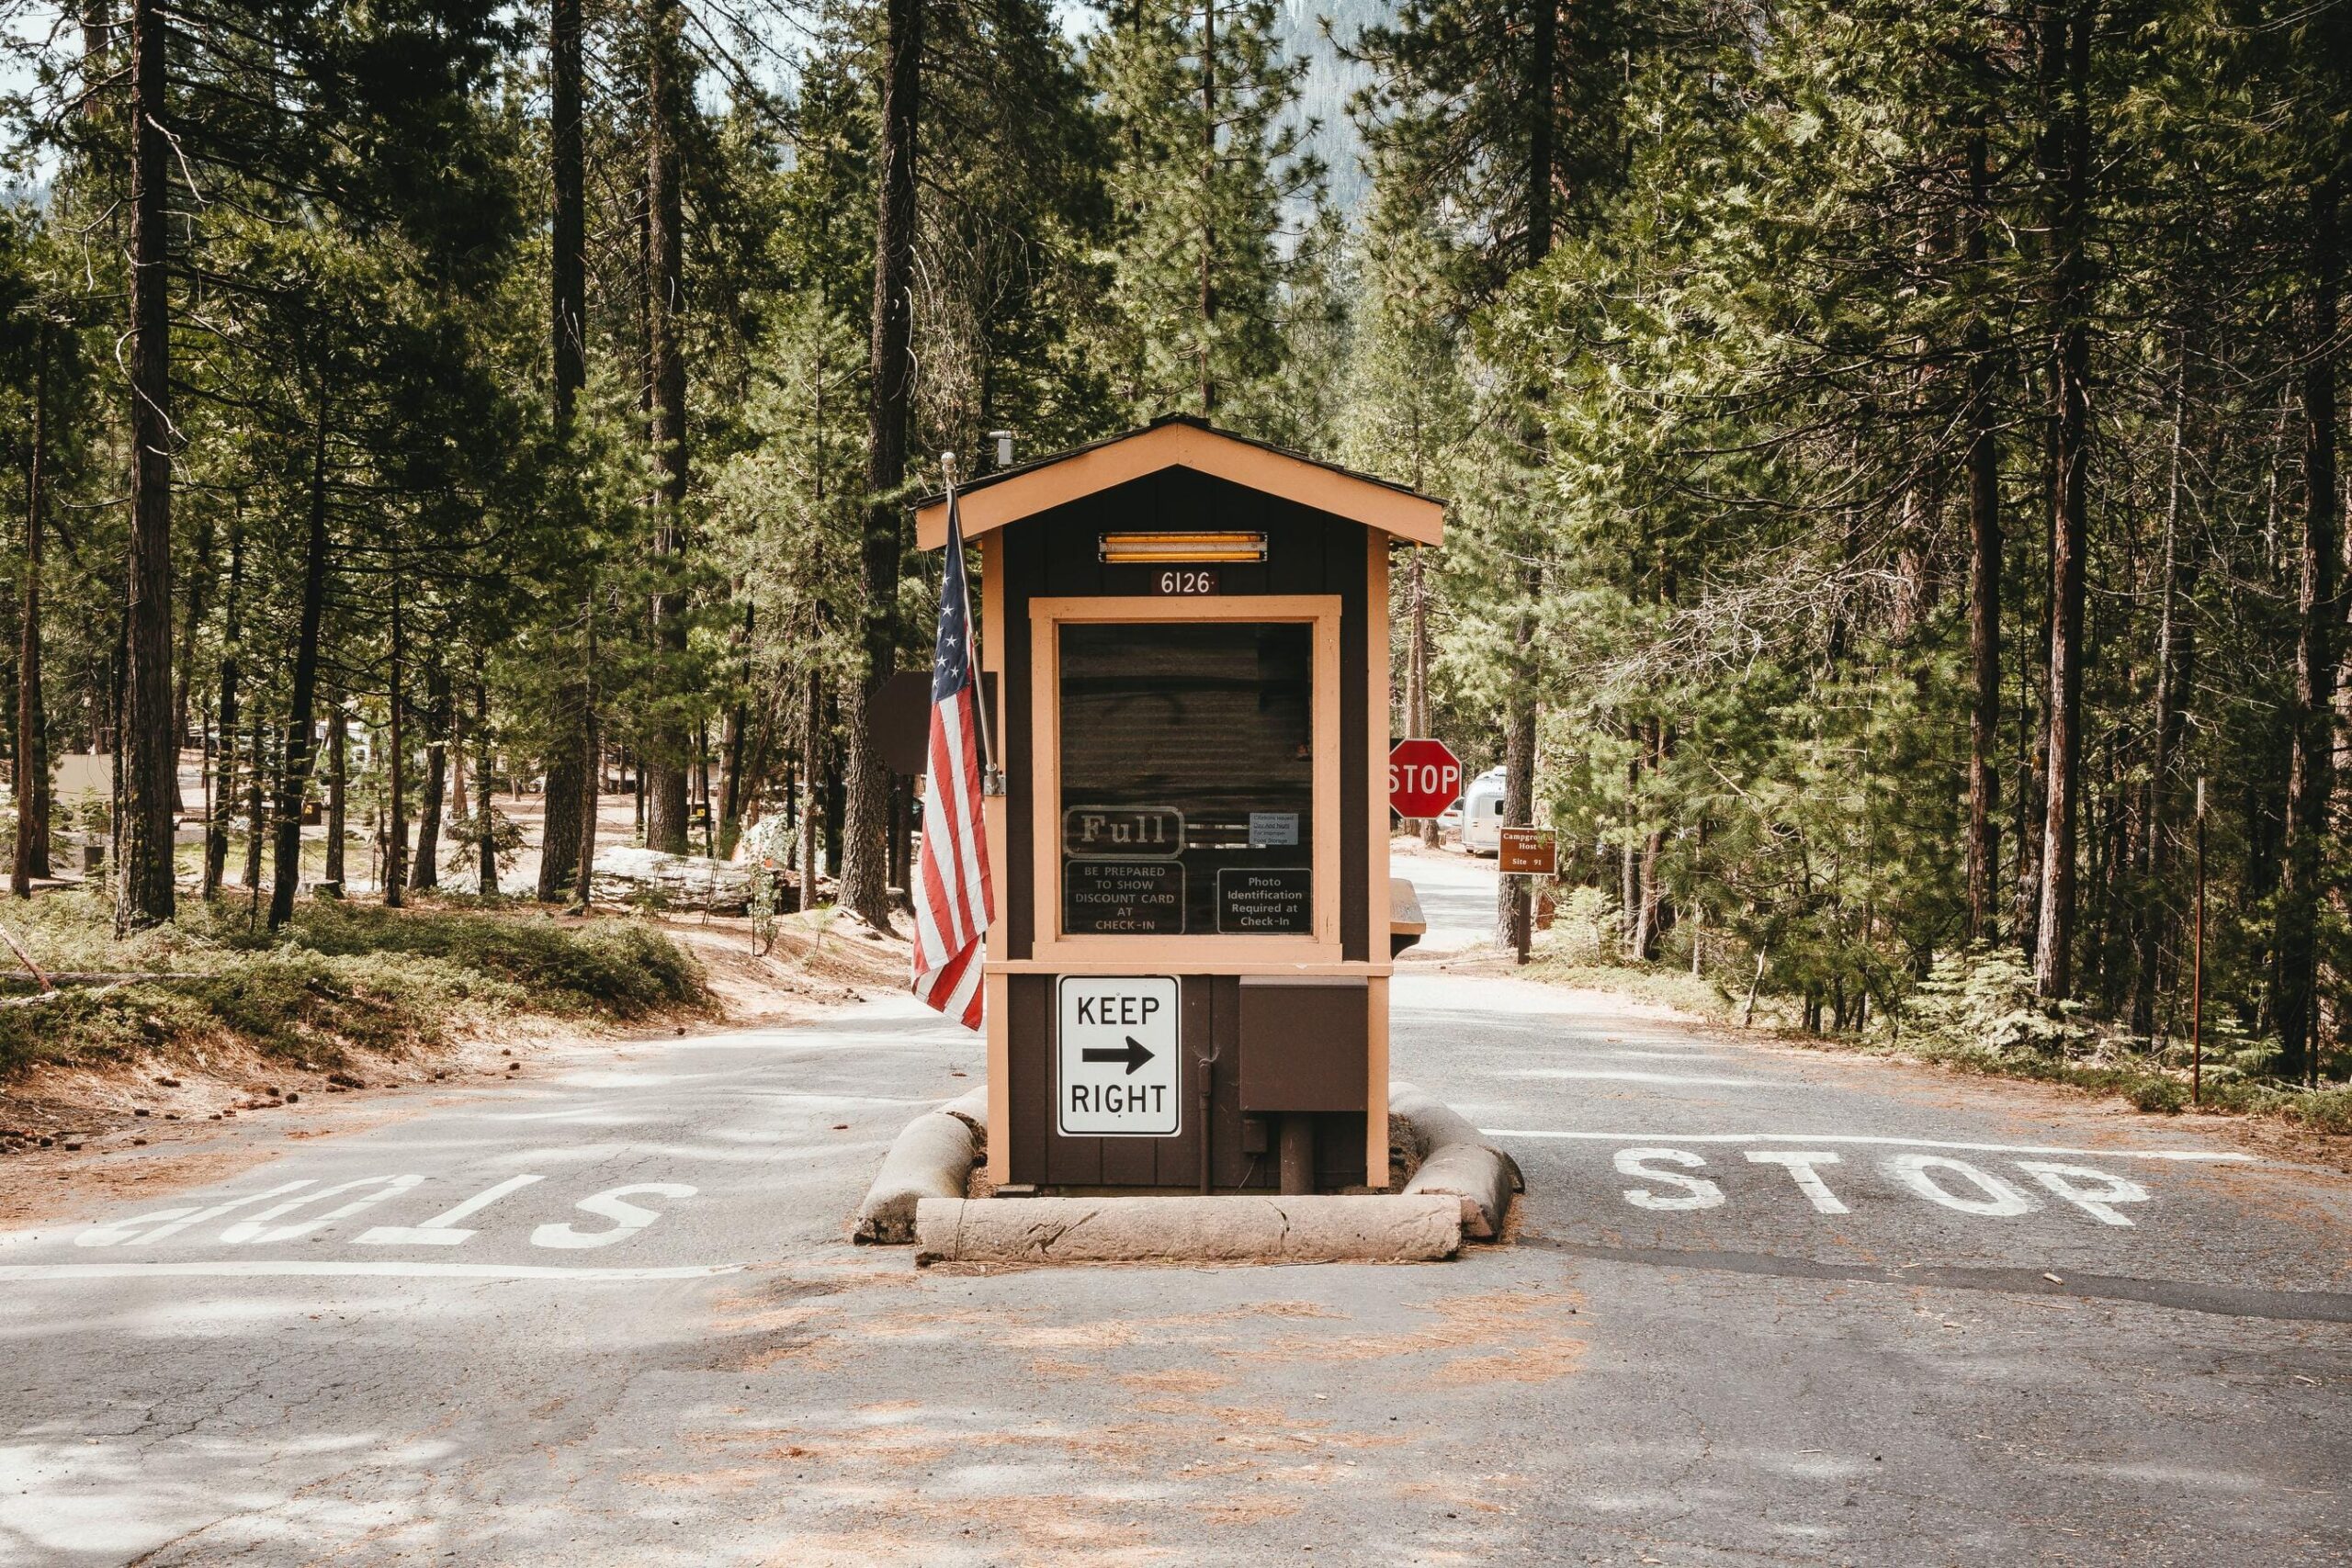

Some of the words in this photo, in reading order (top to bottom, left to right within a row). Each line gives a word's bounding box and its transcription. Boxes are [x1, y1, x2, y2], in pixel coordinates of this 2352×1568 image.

[1160, 571, 1210, 593] 6126
[1389, 764, 1459, 795] STOP
[1080, 815, 1166, 843] Full
[1503, 832, 1554, 842] Campgro
[1512, 857, 1527, 865] Site
[1084, 867, 1100, 876] BE
[1104, 867, 1166, 876] PREPARED
[1096, 880, 1113, 890] TO
[1117, 880, 1154, 890] SHOW
[1248, 877, 1282, 887] Photo
[1075, 894, 1136, 904] DISCOUNT
[1141, 894, 1175, 904] CARD
[1227, 890, 1303, 900] Identification
[1116, 908, 1133, 917] AT
[1231, 903, 1282, 916] Required
[1286, 904, 1298, 913] at
[1095, 919, 1156, 931] CHECK-IN
[1240, 916, 1290, 927] Check-In
[1078, 997, 1160, 1025] KEEP
[1071, 1084, 1167, 1113] RIGHT
[1611, 1146, 2152, 1226] STOP
